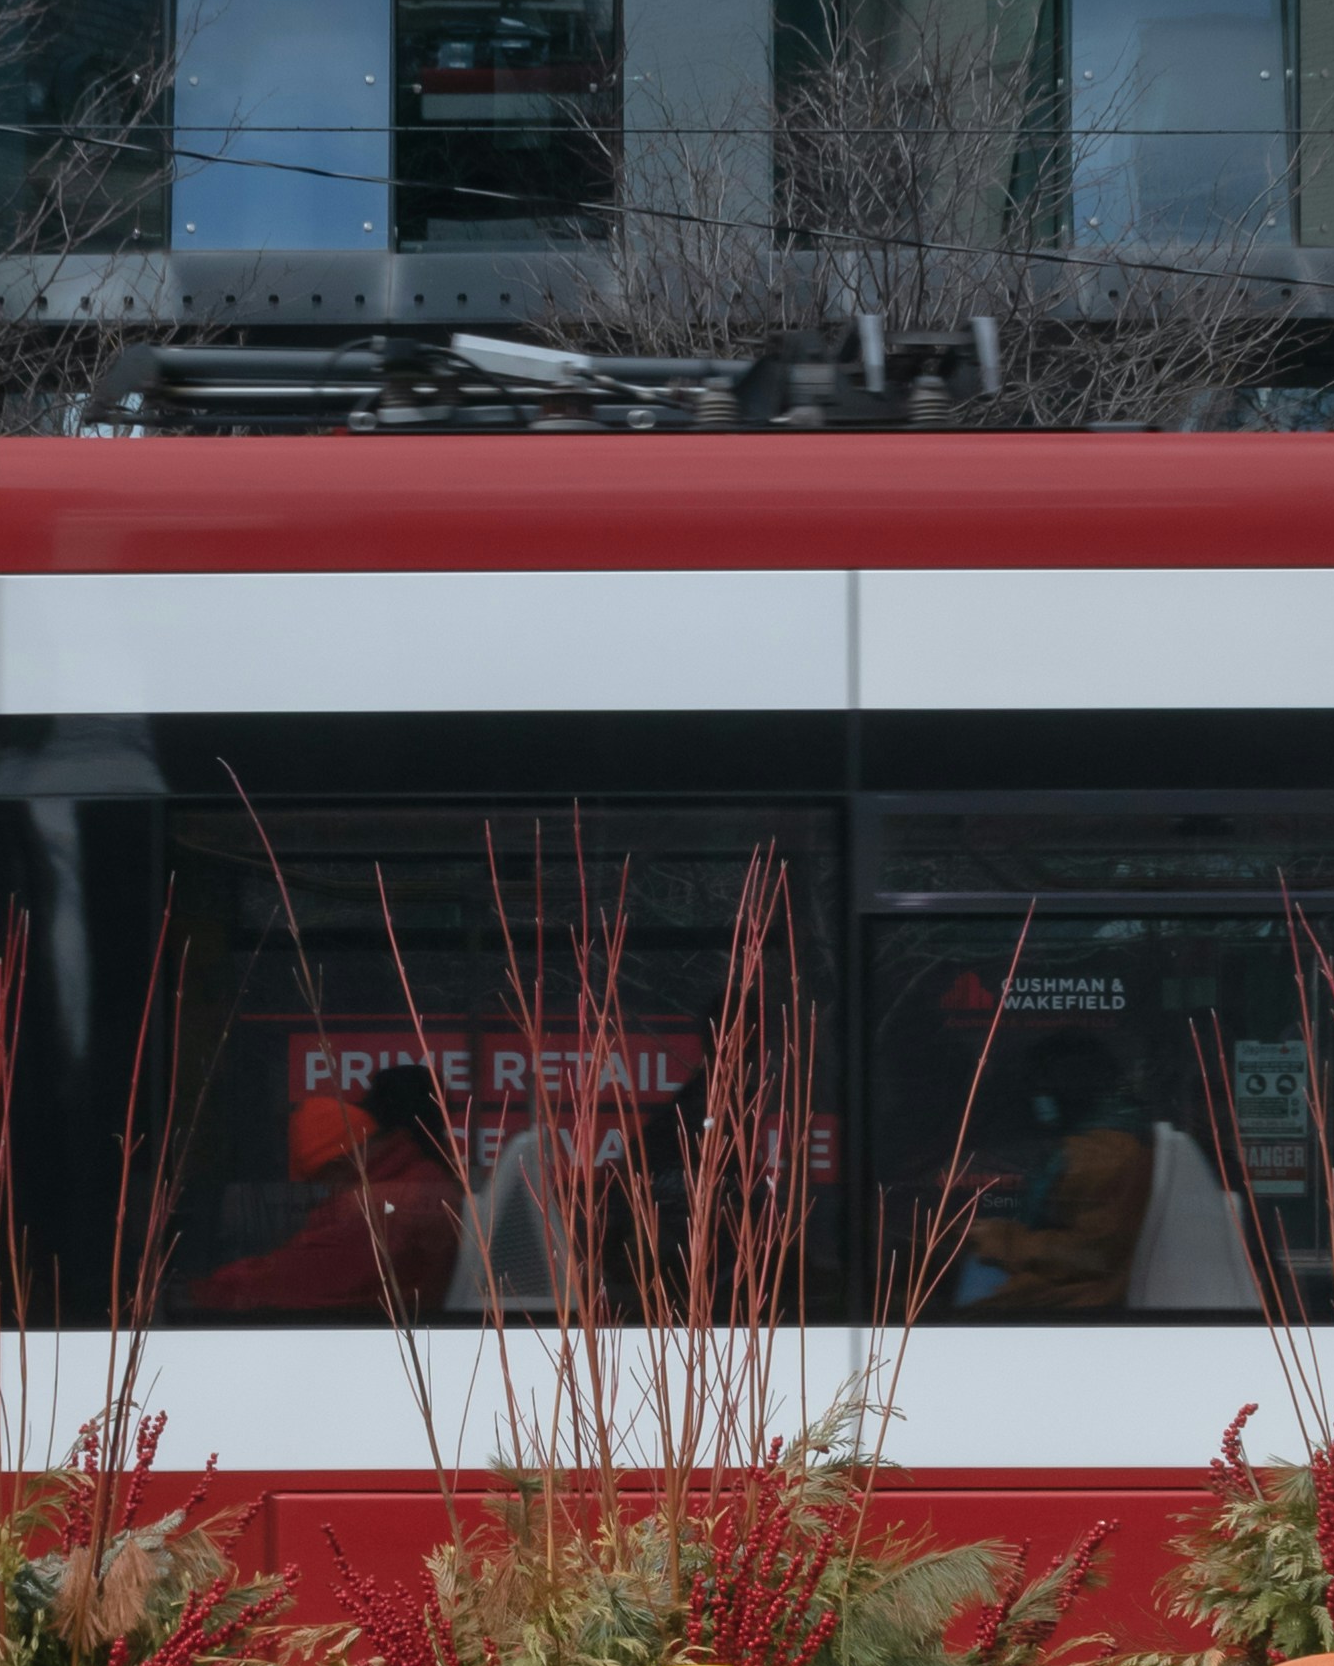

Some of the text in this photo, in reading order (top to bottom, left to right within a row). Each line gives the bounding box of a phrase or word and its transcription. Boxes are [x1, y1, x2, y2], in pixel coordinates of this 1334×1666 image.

[1001, 977, 1126, 993] CUSHMAN &
[1001, 995, 1127, 1010] WAKEFIELD
[493, 1050, 685, 1092] RETAIL
